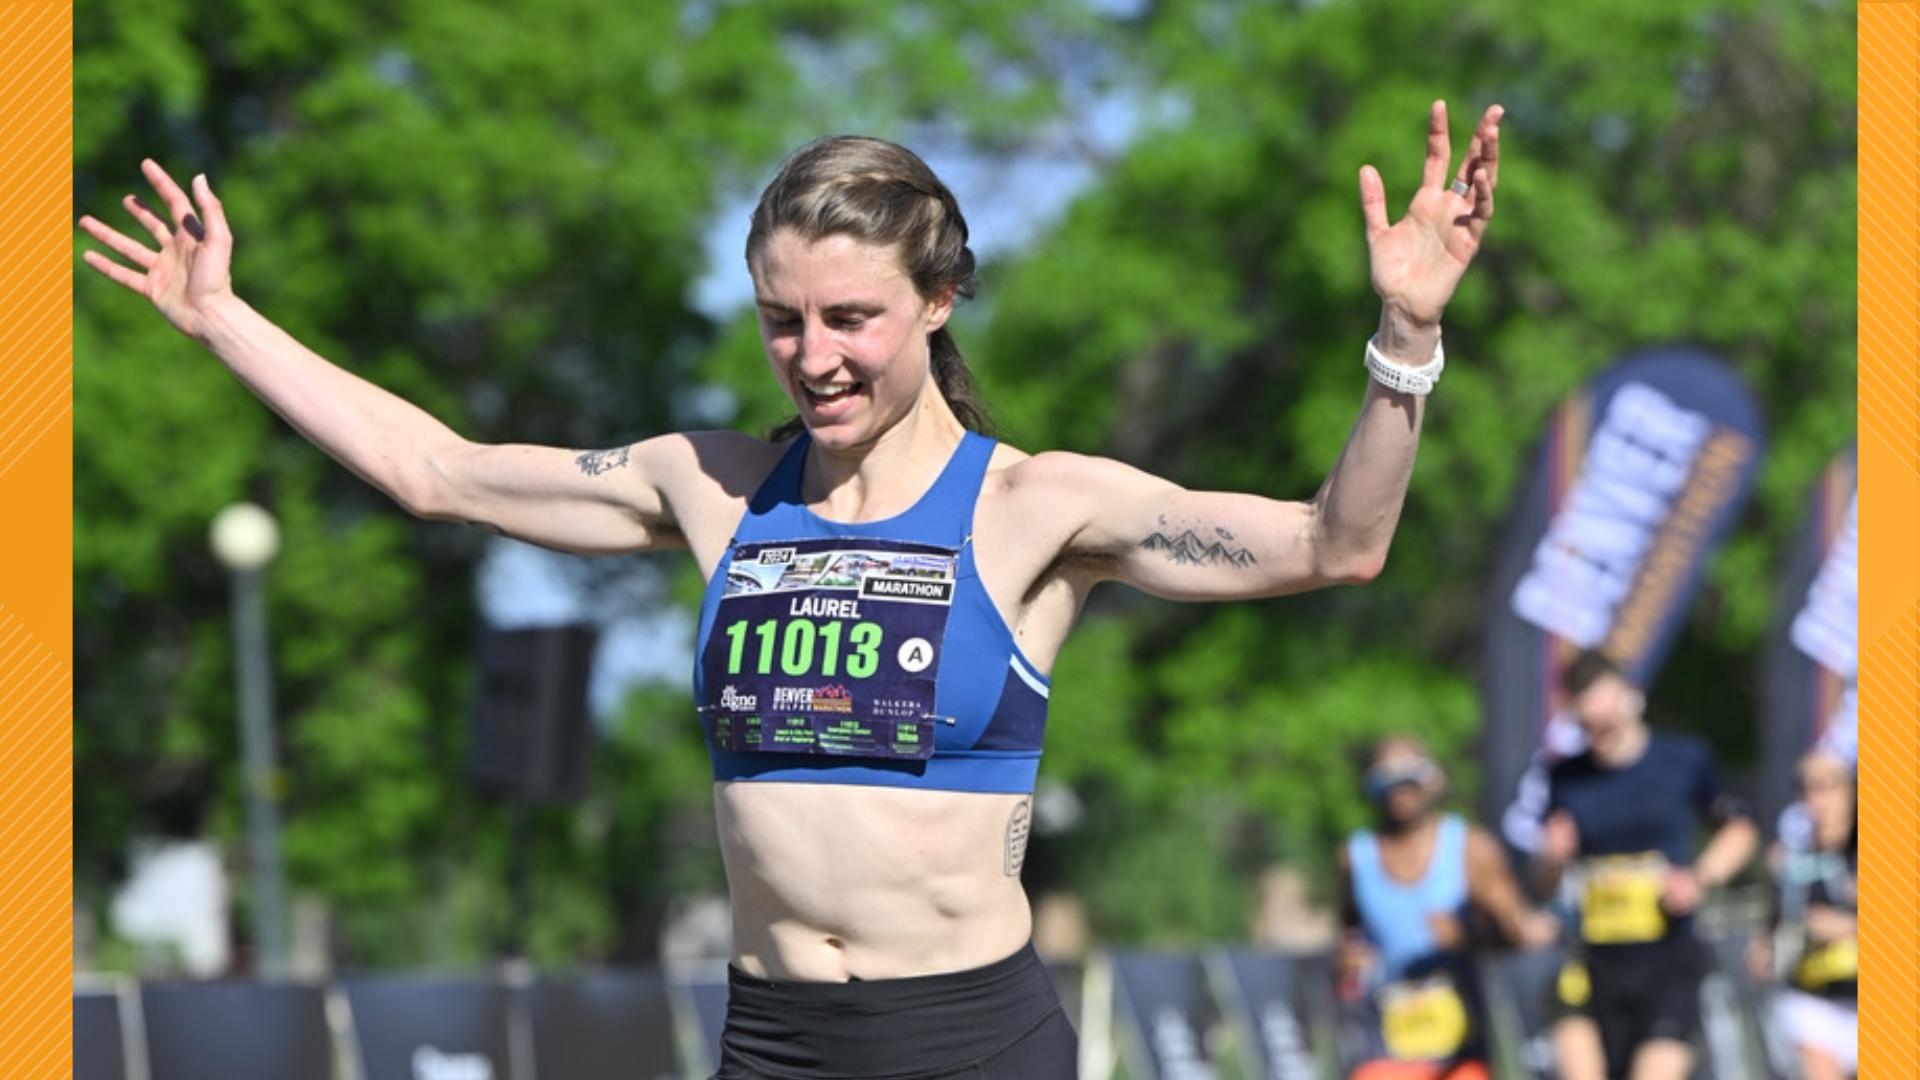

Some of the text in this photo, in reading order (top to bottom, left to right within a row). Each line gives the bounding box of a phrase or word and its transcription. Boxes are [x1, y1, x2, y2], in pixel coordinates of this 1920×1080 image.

[872, 580, 944, 598] MARATHON
[789, 597, 862, 619] LAUREL
[726, 619, 884, 679] 11013
[907, 646, 924, 664] A
[773, 686, 814, 702] DENVER
[872, 707, 915, 717] DUNLOP
